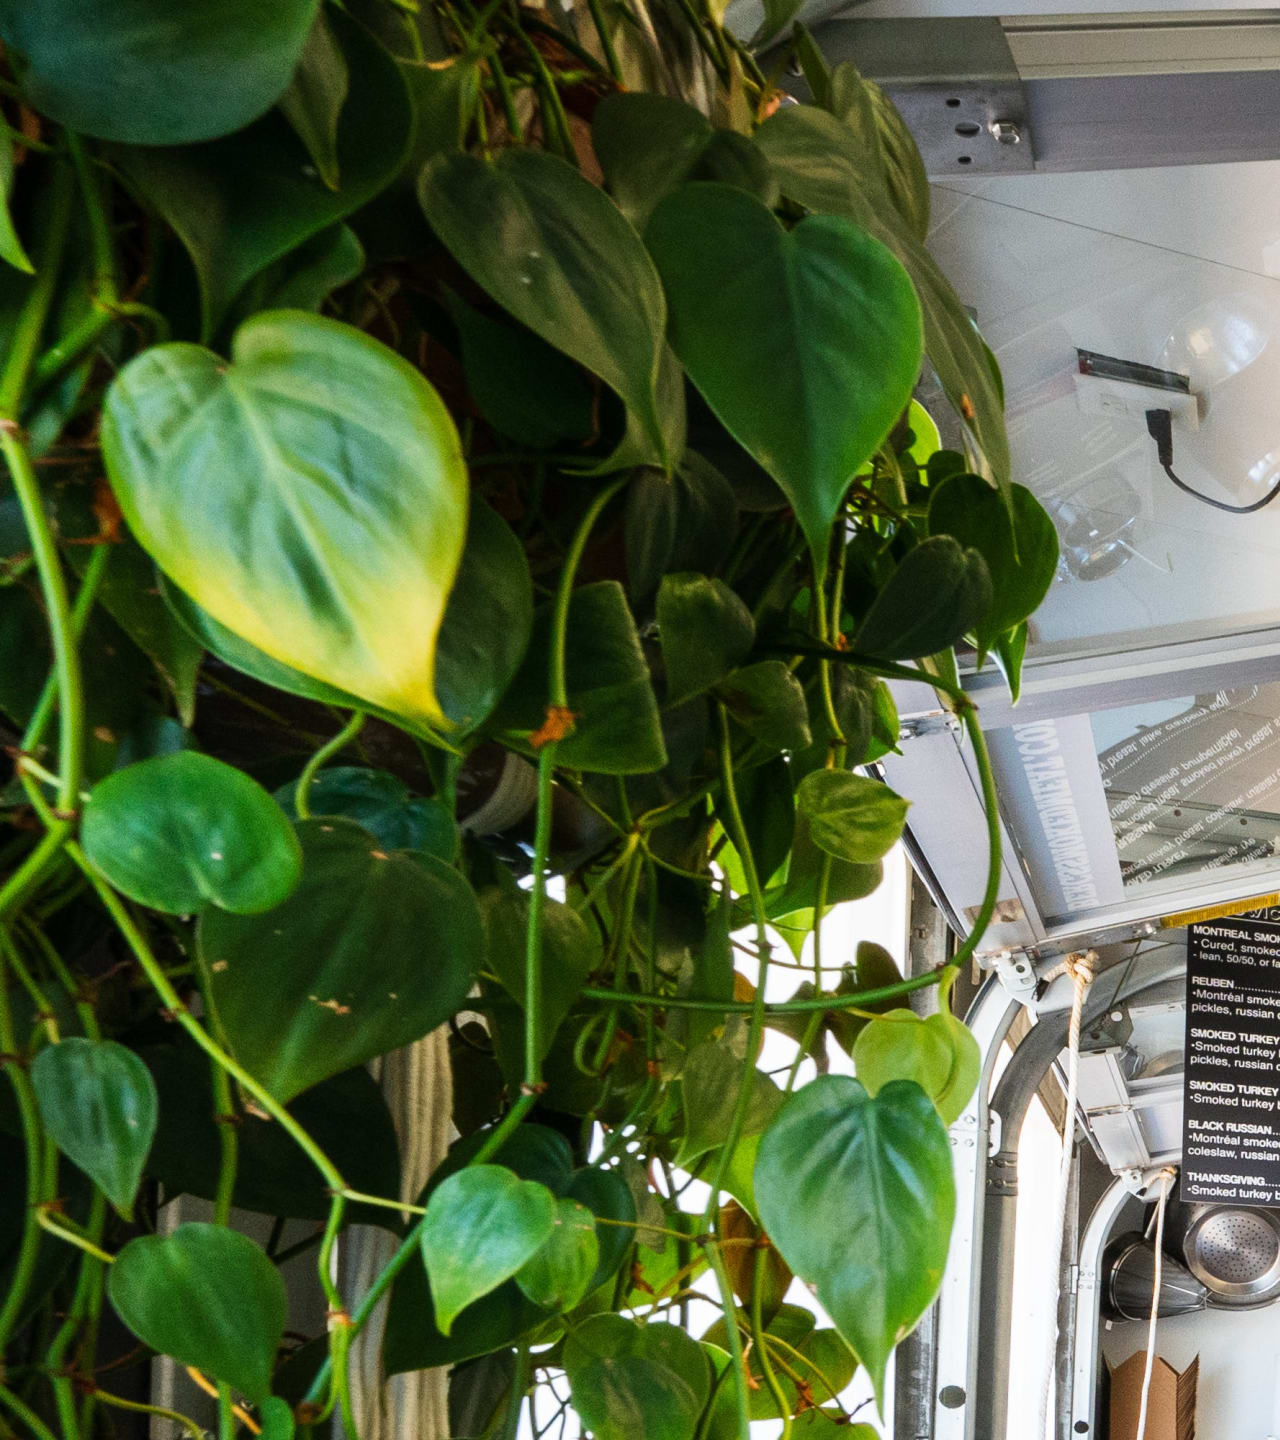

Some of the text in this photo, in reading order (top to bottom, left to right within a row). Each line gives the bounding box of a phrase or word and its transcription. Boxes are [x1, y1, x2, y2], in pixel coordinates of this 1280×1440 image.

[1193, 925, 1251, 940] MONTREAL
[1200, 939, 1236, 952] Cured,
[1191, 976, 1234, 989] REUBEN
[1189, 1081, 1235, 1093] SMOKED
[1237, 1085, 1279, 1096] TURKEY
[1186, 1172, 1267, 1186] THANKSGIVING
